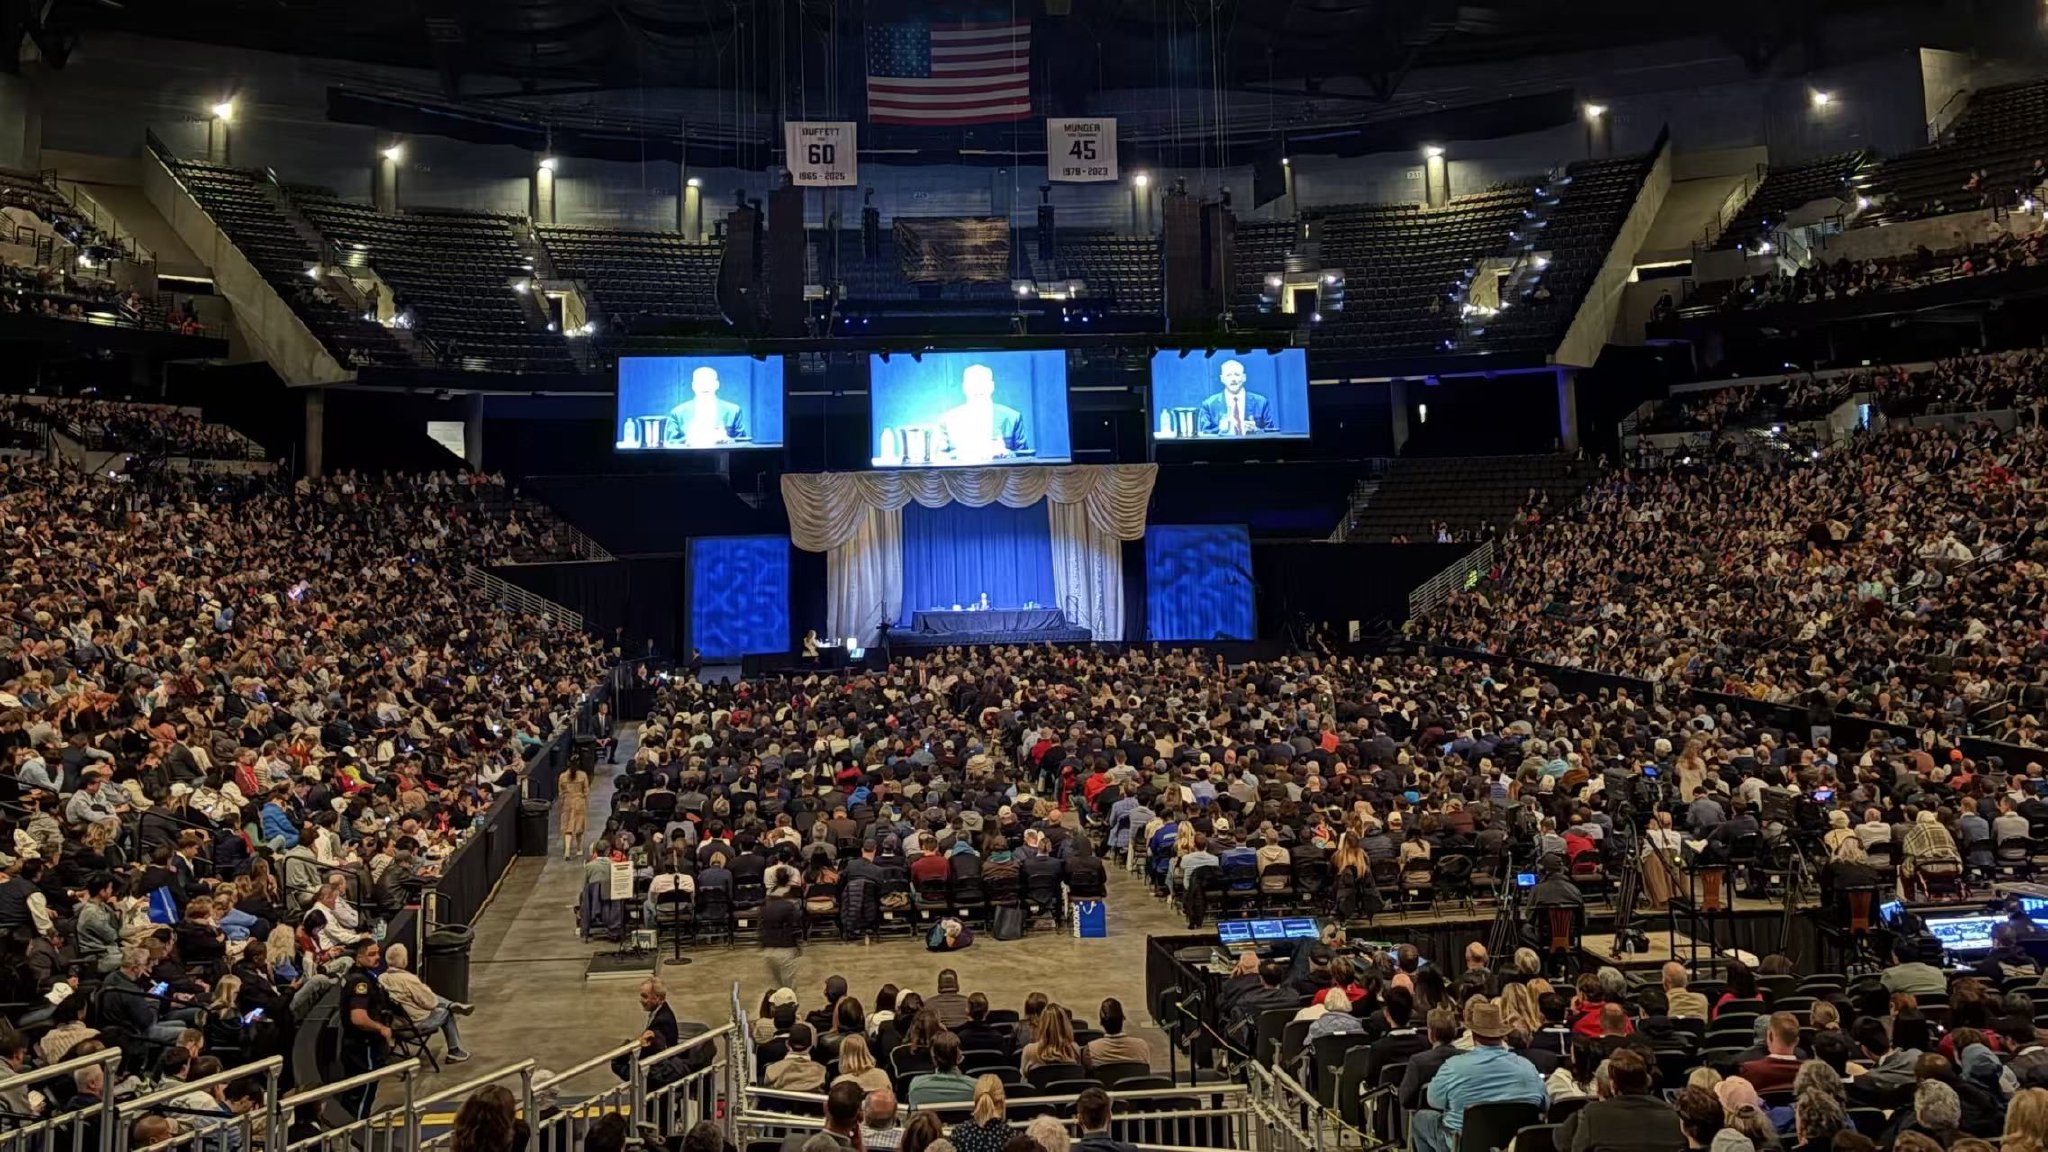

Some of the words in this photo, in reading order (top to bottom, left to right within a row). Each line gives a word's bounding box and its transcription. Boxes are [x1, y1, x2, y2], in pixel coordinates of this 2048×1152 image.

[1064, 123, 1101, 132] MUNGER
[808, 143, 835, 165] 60
[1068, 140, 1096, 160] 45
[799, 171, 818, 180] 1965
[1087, 167, 1108, 176] 2023
